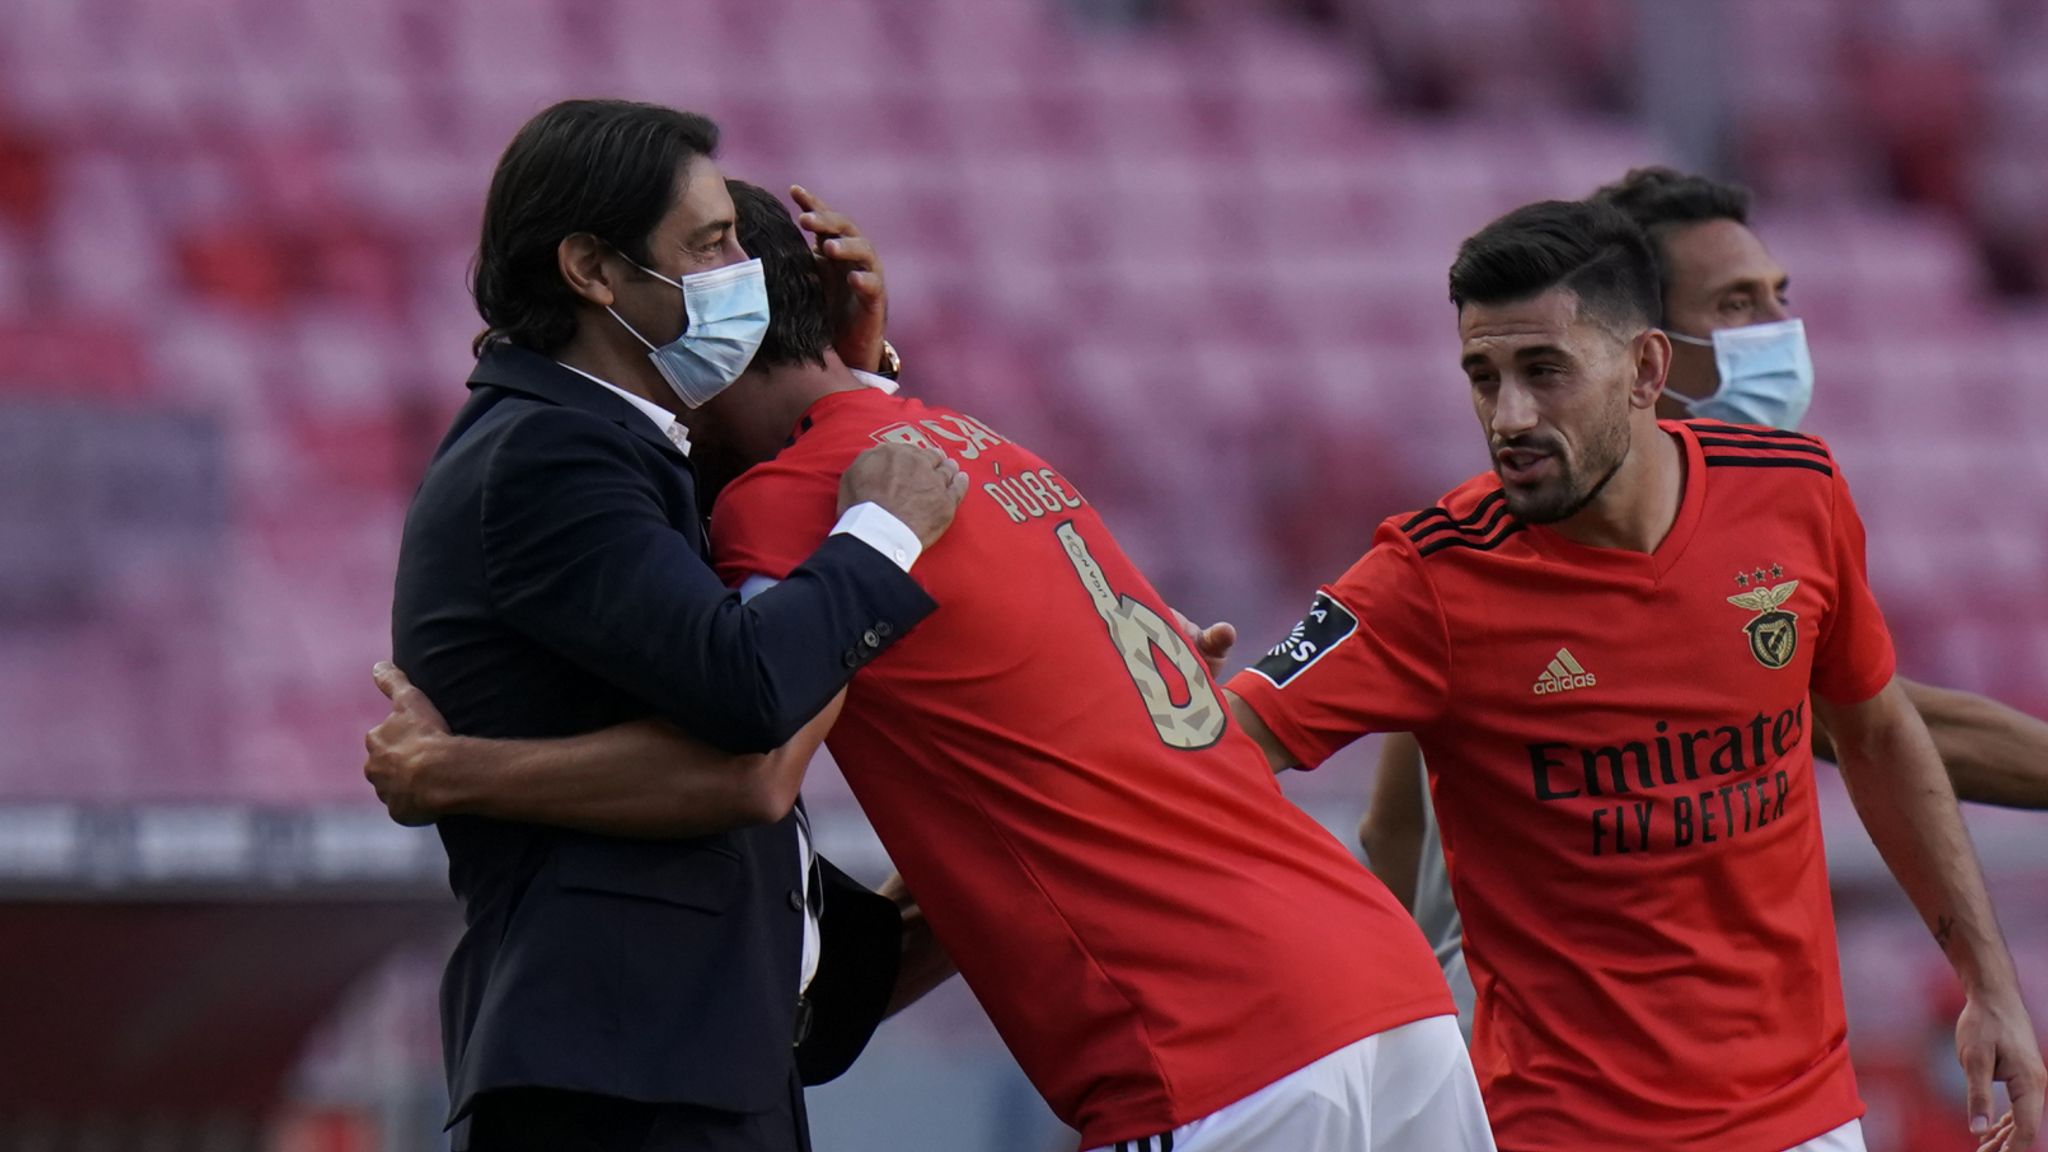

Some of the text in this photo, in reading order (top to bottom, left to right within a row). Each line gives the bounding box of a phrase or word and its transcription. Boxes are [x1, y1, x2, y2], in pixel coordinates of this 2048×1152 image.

[982, 462, 1083, 524] RÚBE
[1054, 518, 1228, 751] 6
[1533, 673, 1597, 694] adidas
[1592, 769, 1789, 857] FLY BETTER
